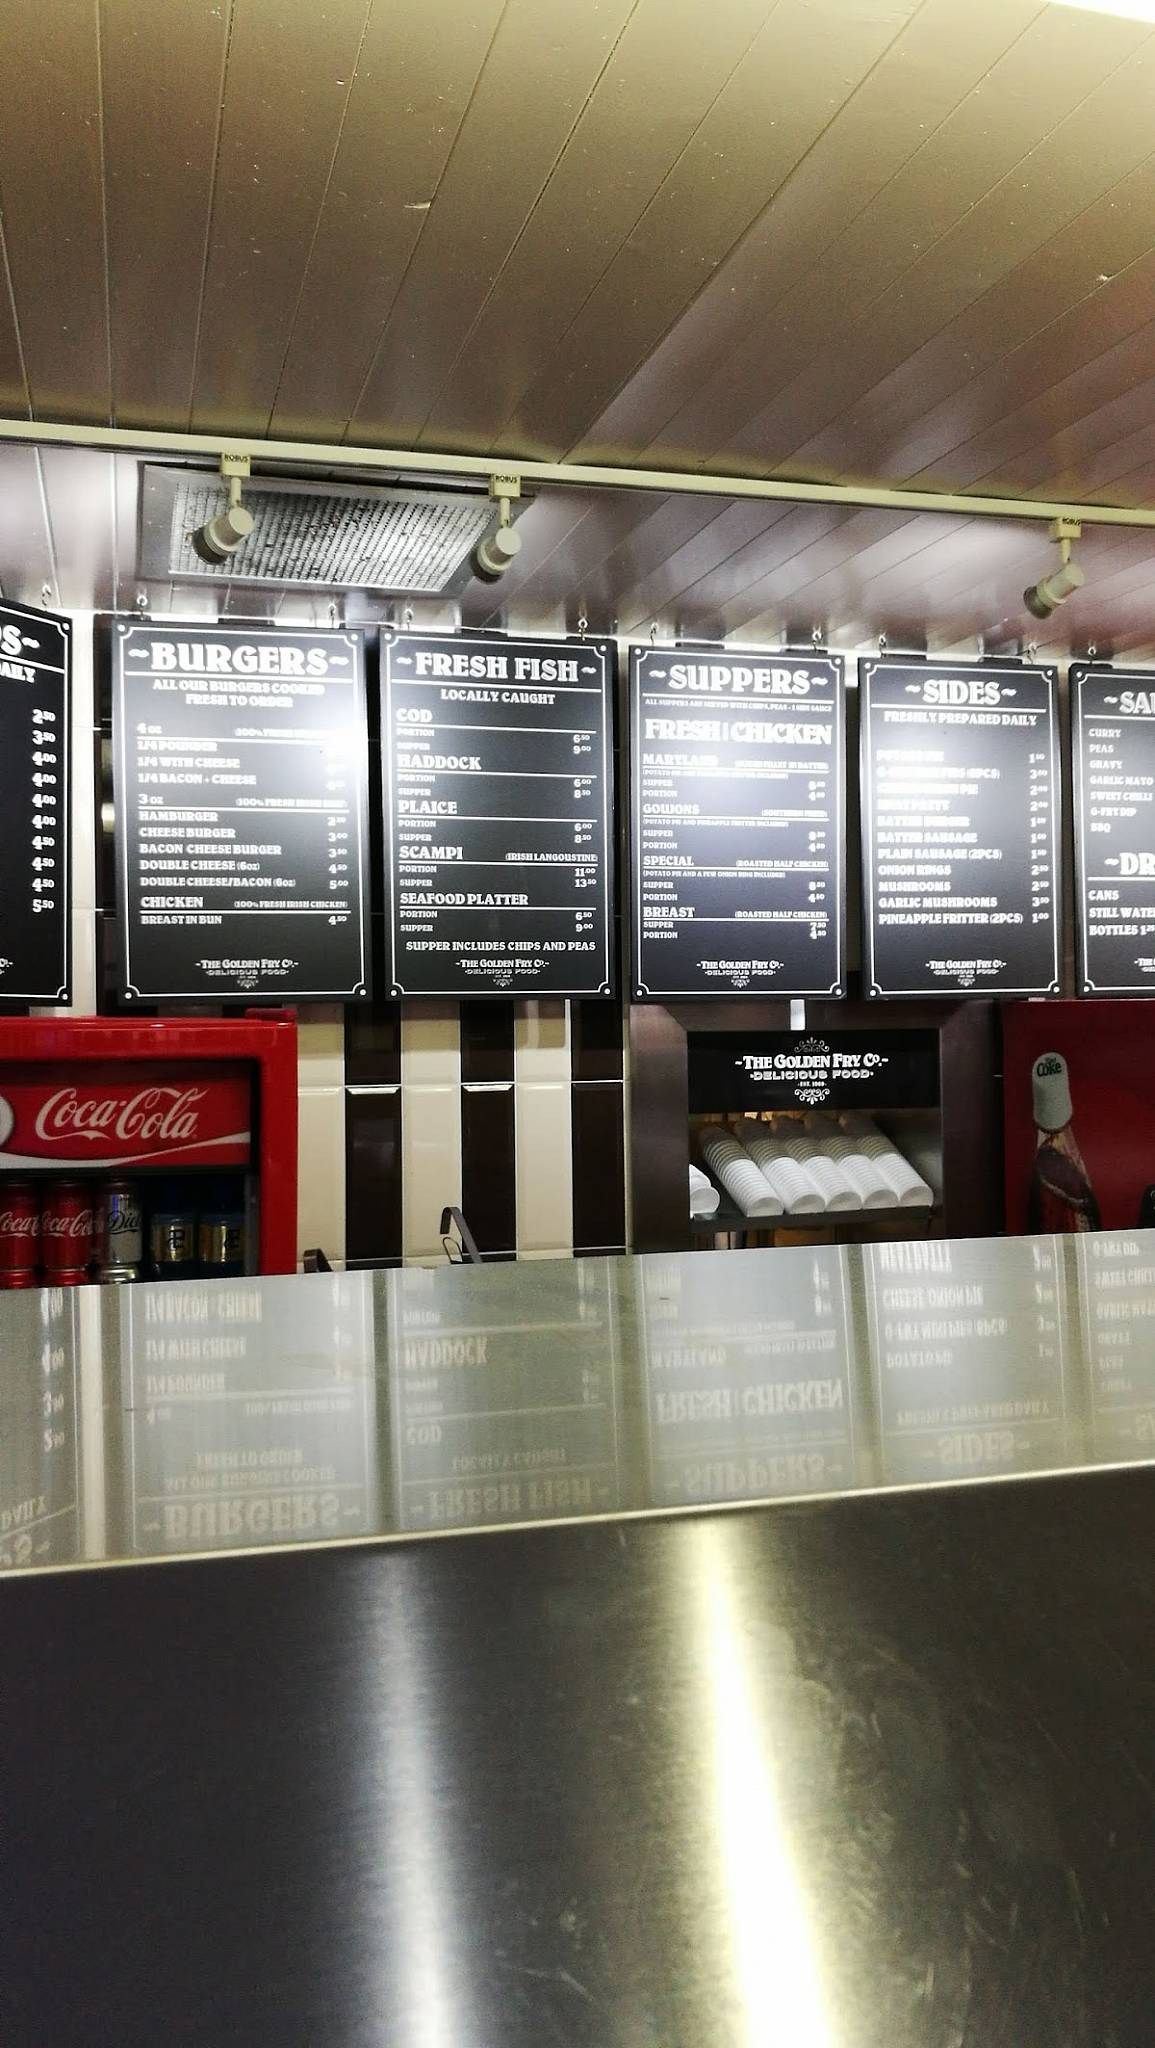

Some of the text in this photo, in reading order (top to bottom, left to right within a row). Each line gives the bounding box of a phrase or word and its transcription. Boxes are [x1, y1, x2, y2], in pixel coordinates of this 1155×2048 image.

[0, 624, 21, 655] S
[151, 642, 328, 675] BURGERS
[416, 652, 579, 682] FRESH FISH
[668, 664, 811, 695] SUPPERS
[154, 680, 325, 695] ALL OUR BURGERS COOKED
[923, 679, 1001, 705] SIDES
[186, 694, 293, 708] FRESH TO ORDER
[440, 689, 555, 704] LOCALLY CAUGHT
[1119, 691, 1155, 714] SA
[396, 708, 433, 722] COD
[884, 712, 1037, 726] FRESHLY PREPARED DAILY
[645, 718, 832, 745] FRESH CHICKEN
[1088, 729, 1121, 737] CURRY
[1090, 744, 1114, 753] PEAS
[160, 757, 240, 768] WITH CHEESE
[397, 754, 482, 770] HADDOCK
[1090, 760, 1122, 769] GRAVY
[160, 774, 256, 785] BACON CHEESE
[1090, 776, 1153, 785] GARLIC MAYO
[139, 794, 148, 804] 3
[398, 800, 457, 814] PLAICE
[139, 812, 218, 822] HAMBURGER
[399, 820, 436, 828] PORTION
[139, 828, 184, 838] CHEESE
[186, 829, 236, 838] BURGER
[399, 833, 432, 841] SUPPER
[140, 844, 282, 855] BACON CHEESE BURGER
[399, 846, 463, 860] SCAMPI
[914, 849, 967, 859] SAUSAGE
[140, 860, 189, 870] DOUBLE
[190, 860, 235, 870] CHEESE
[643, 856, 694, 866] SPECIAL
[399, 865, 437, 873] PORTION
[878, 865, 916, 875] ONION
[140, 877, 187, 887] DOUBLE
[400, 879, 432, 887] SUPPER
[879, 882, 951, 892] MUSHROOMS
[400, 893, 528, 905] SEAFOOD PLATTER
[1088, 890, 1119, 901] CANS
[141, 897, 203, 908] CHICKEN
[259, 900, 286, 909] FRESH
[879, 897, 997, 908] GARLIC MUSHROOMS
[643, 907, 695, 917] BREAST
[1089, 907, 1119, 918] STILL
[141, 916, 184, 925] BREAST
[185, 916, 198, 925] IN
[199, 916, 222, 925] BUN
[879, 914, 942, 925] PINEAPPLE
[944, 913, 989, 924] FRITTER
[990, 913, 1023, 924] (2PCS)
[400, 924, 433, 932] SUPPER
[1089, 924, 1138, 936] BOTTLES
[643, 931, 678, 939] PORTION
[406, 942, 596, 951] SUPPER INCLUDES CHIPS AND PEAS
[261, 960, 280, 968] FRY
[515, 959, 532, 967] FRY
[743, 1053, 861, 1070] THE GOLDEN FRY
[753, 1070, 869, 1080] DELICIOUS FOOD
[1036, 1062, 1062, 1077] Coke
